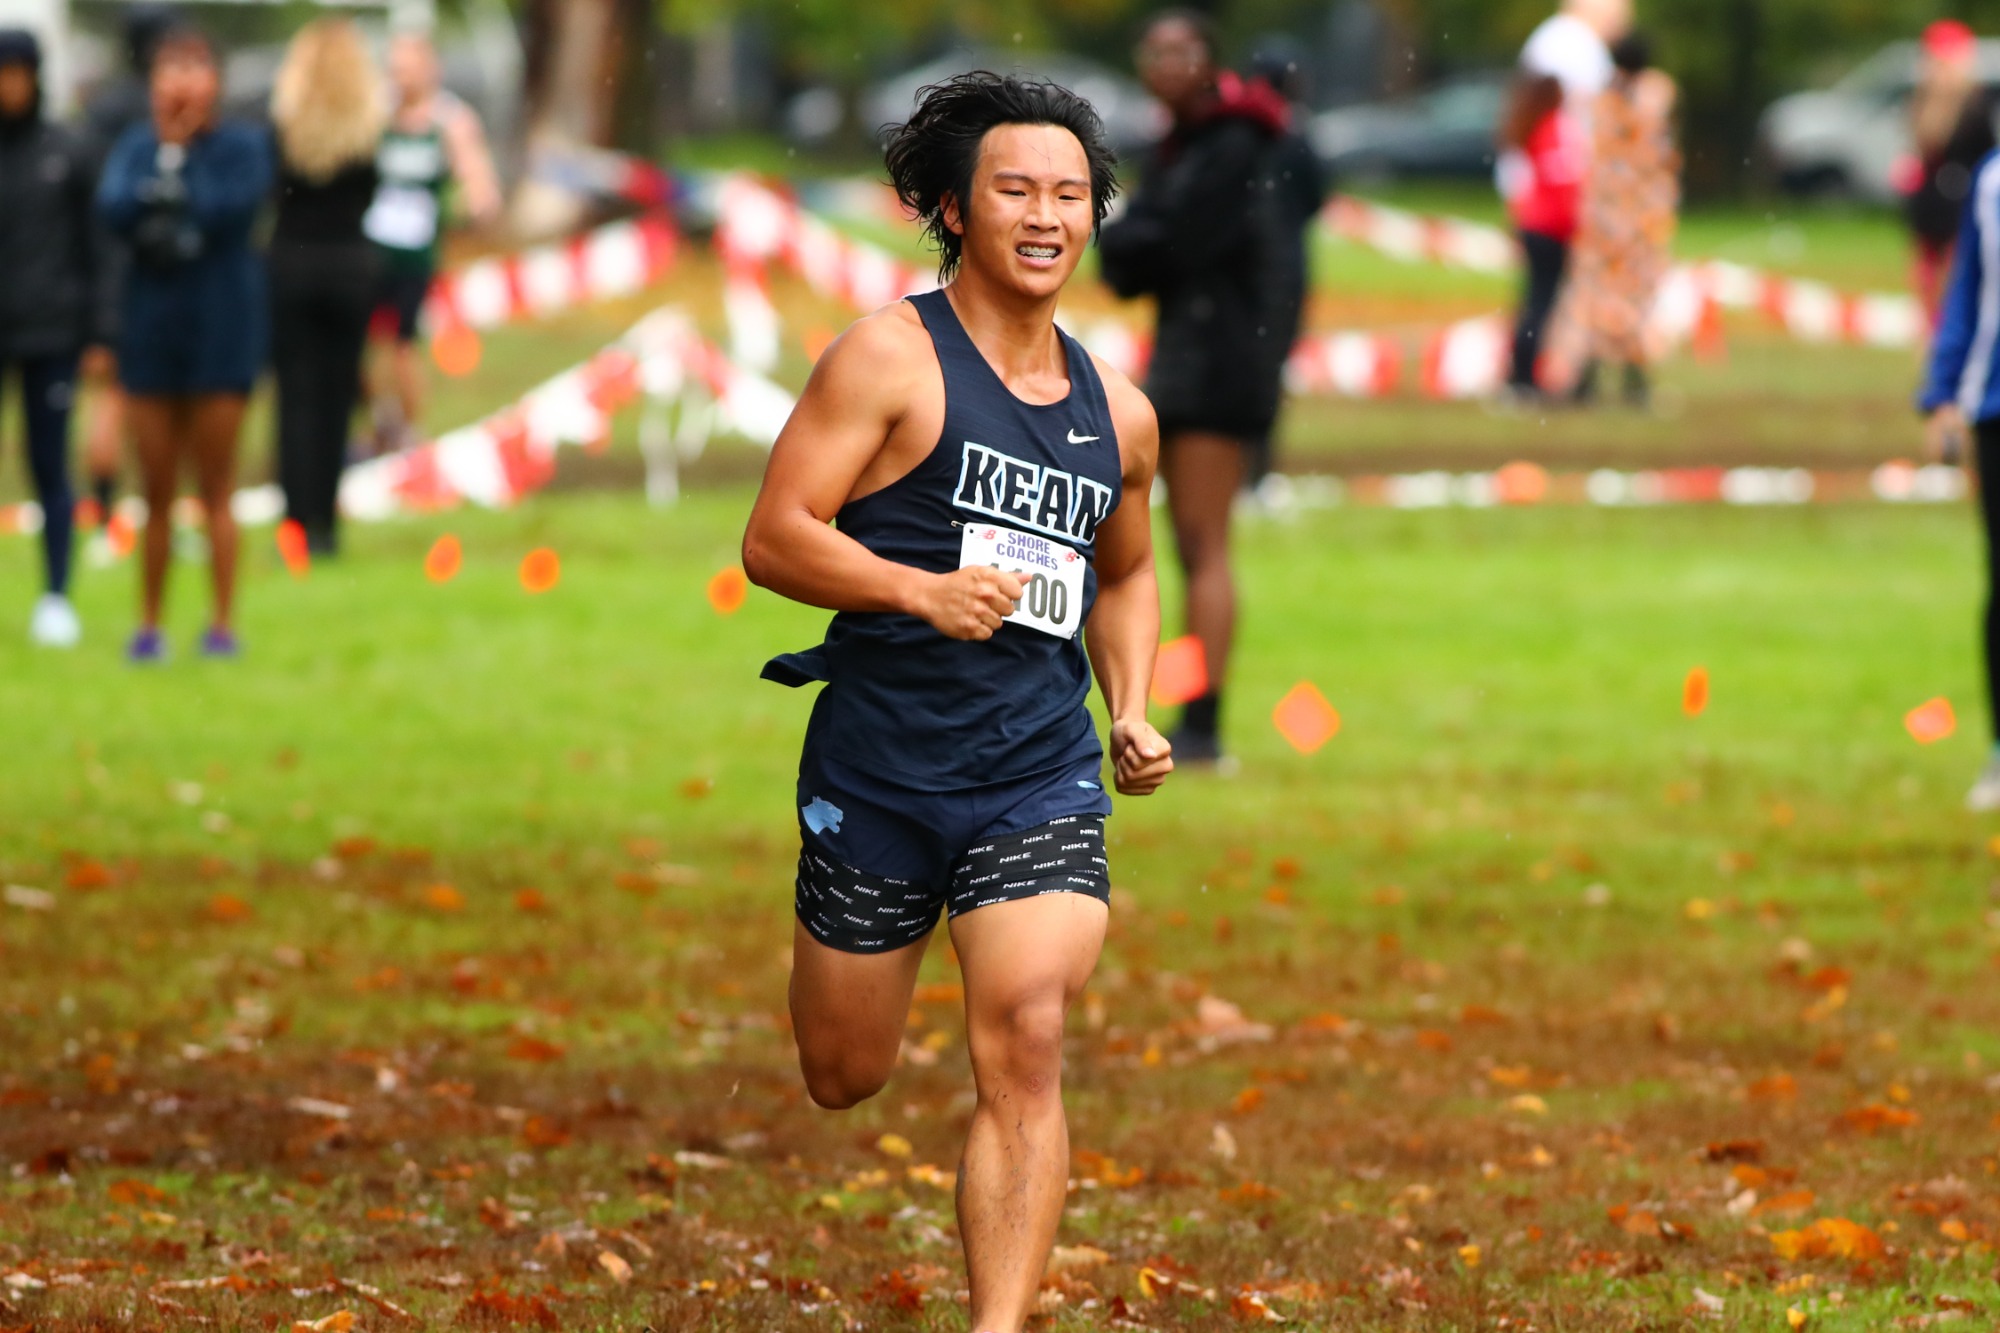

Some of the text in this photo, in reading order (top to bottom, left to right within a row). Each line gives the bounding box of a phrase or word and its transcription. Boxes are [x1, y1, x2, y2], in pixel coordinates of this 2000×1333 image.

[952, 441, 1112, 546] KEAN
[1008, 531, 1051, 554] SHORE
[996, 543, 1059, 571] COACHES
[991, 562, 1067, 625] 00
[1049, 817, 1076, 825] NIKE
[1023, 833, 1054, 844] NIKE
[968, 845, 995, 855] NIKE
[1061, 842, 1089, 851] NIKE
[999, 851, 1032, 863] NIKE
[1033, 859, 1066, 870] NIKE
[969, 872, 1001, 884] NIKE
[1067, 877, 1095, 887] NIKE
[1003, 879, 1037, 889] NIKE
[829, 887, 854, 904] NIKE
[854, 885, 881, 897] NIKE
[955, 890, 975, 901] NIKE
[977, 896, 1008, 906] NIKE
[843, 913, 874, 927] NIKE
